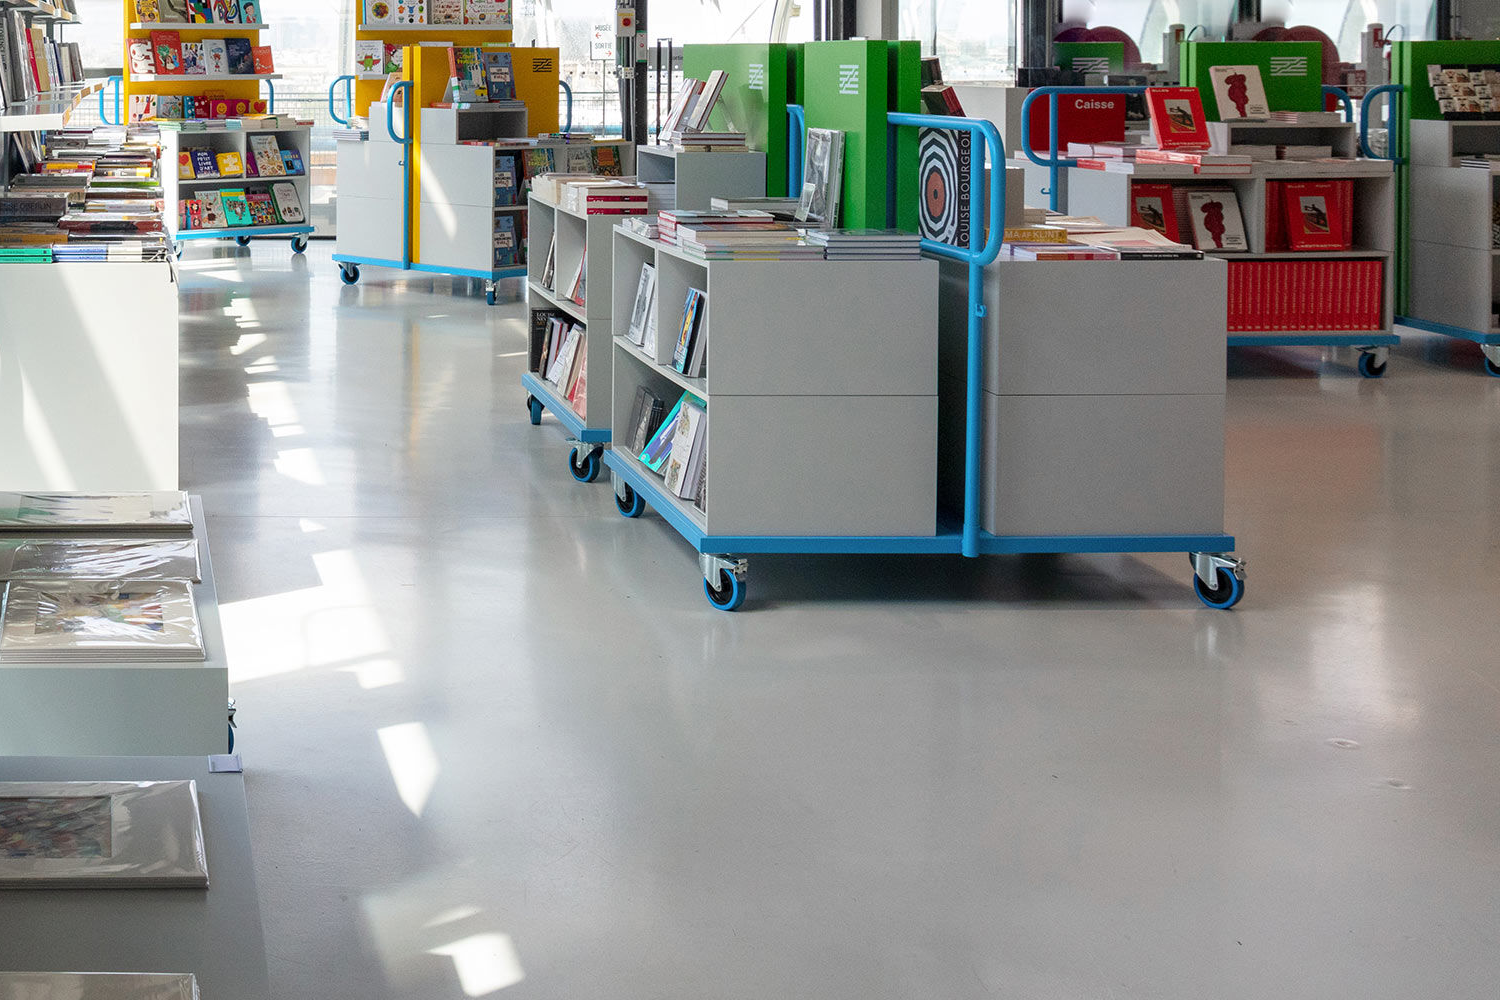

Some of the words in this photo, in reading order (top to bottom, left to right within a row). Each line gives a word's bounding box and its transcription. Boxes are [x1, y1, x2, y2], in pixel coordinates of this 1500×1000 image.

[595, 23, 612, 32] MUSÉE
[595, 42, 613, 50] SORTIE
[1075, 99, 1115, 110] Caisse
[960, 130, 972, 200] BOURGEOI
[960, 204, 970, 250] LOUISE
[1033, 230, 1060, 239] KLINT
